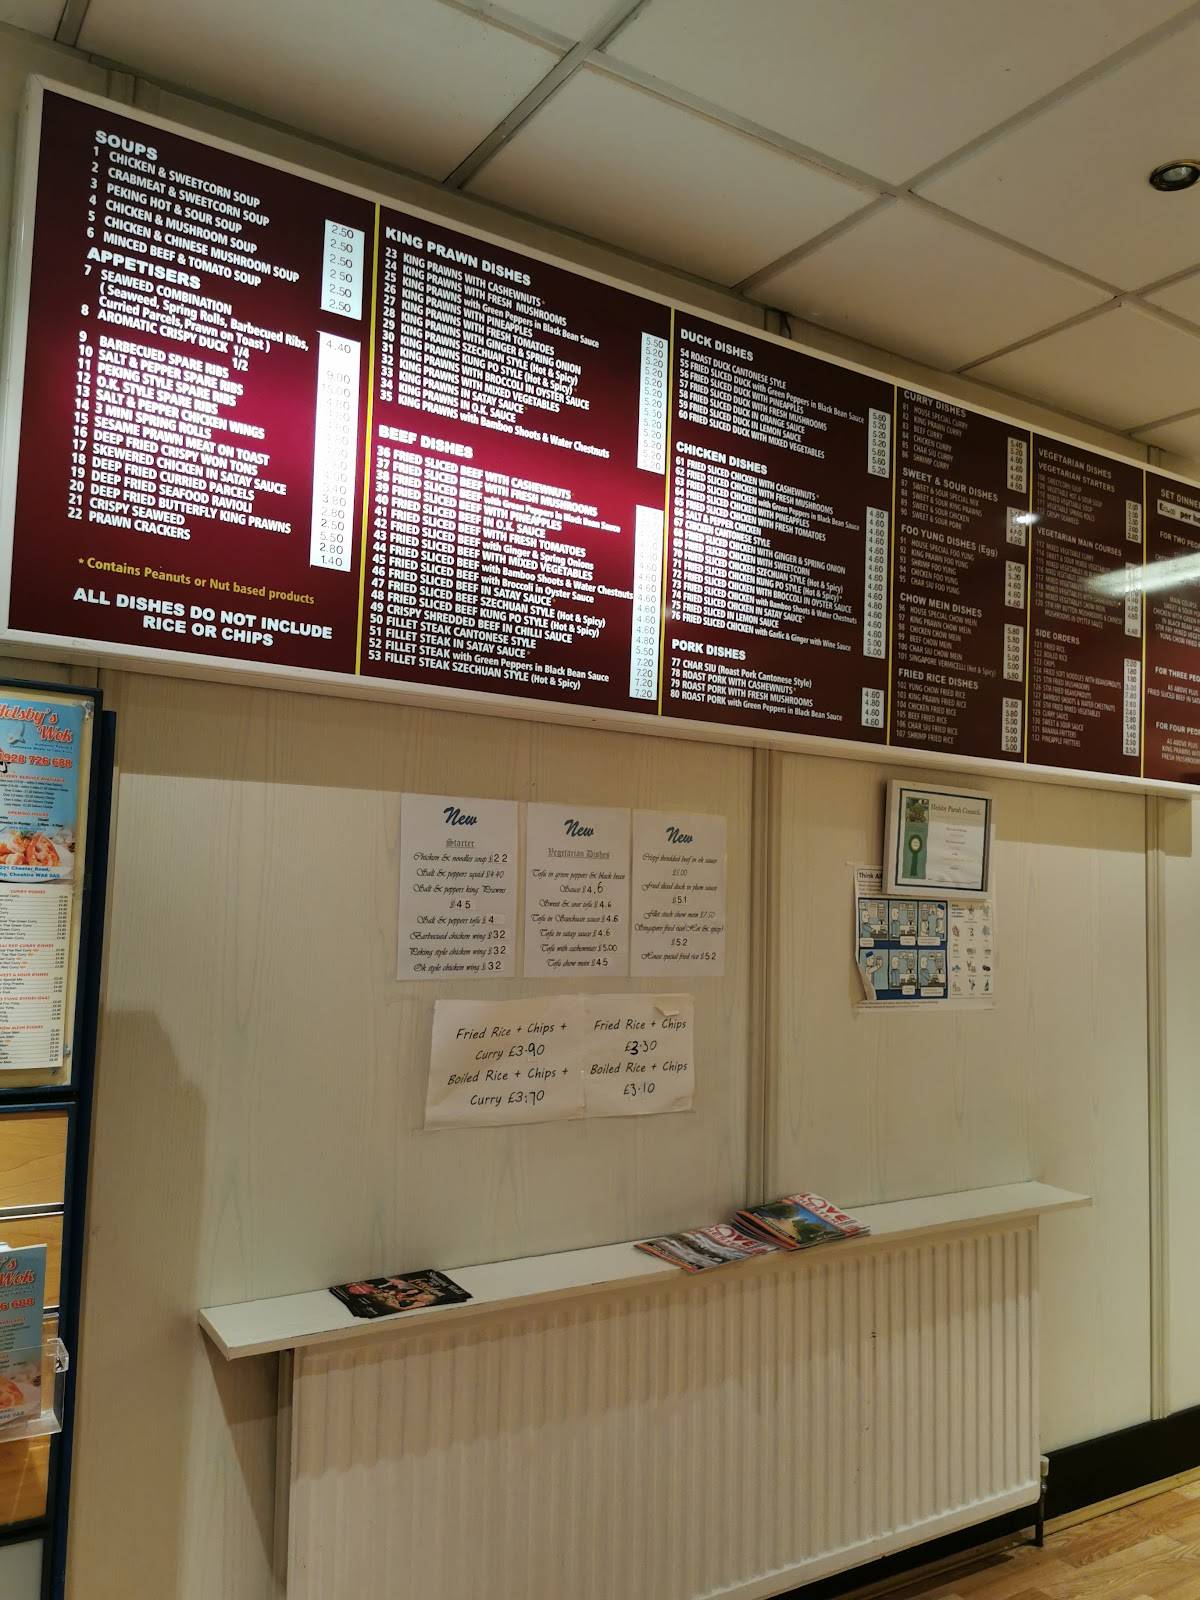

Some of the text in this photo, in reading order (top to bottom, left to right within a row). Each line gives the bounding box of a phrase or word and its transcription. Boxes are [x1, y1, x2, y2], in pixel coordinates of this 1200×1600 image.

[95, 129, 157, 161] SOUPS
[93, 145, 354, 241] 1 CHICKEN & SWEETCORN SOUP 2.50
[87, 246, 200, 289] APPETISERS
[385, 226, 530, 286] KING PRAWN DISHES
[84, 265, 232, 314] 7 SEAWEED COMBINATION
[385, 246, 540, 307] 23 KING PRAWNS WITH CASHEWNUTS
[680, 327, 753, 361] DUCK DISHES
[680, 347, 785, 389] 54 ROAST DUCK CANTONESE STYLE
[378, 425, 473, 459] BEEF DISHES
[676, 440, 767, 475] CHICKEN DISHES
[903, 467, 932, 483] SWEET
[944, 478, 966, 493] SOUR
[969, 486, 998, 502] DISHES
[1087, 463, 1112, 479] DISHES
[67, 508, 343, 567] 22 PRAWN CRACKERS 1.40
[901, 524, 998, 557] FOO YUNG DISHES (Egg)
[86, 557, 314, 604] Contains Peanuts or Nut based products
[73, 589, 332, 638] ALL DISHES DO NOT INCLUDE
[900, 592, 982, 618] CHOW MEIN DISHES
[142, 616, 273, 646] RICE OR CHIPS
[370, 613, 653, 668] 50 FILLET STEAK CANTONESE STYLE 7.20
[1035, 629, 1080, 645] SIDE ORDERS
[672, 638, 745, 660] PORK DISHES
[368, 649, 652, 699] 53 FILLET STEAK SZECHUAN STYLE (Hot & Spicy) 7.20
[671, 656, 811, 687] 77 CHAR SIU (Roast Pork Cantonese Style)
[899, 668, 978, 690] FRIED RICE DISHES
[671, 678, 812, 707] 79 ROAST PORK WITH FRESH MUSHROOMS
[443, 807, 477, 826] New
[564, 819, 594, 837] New
[665, 826, 694, 844] New
[456, 1025, 486, 1040] Fried
[491, 1026, 511, 1038] Rice
[527, 1022, 555, 1036] Chips
[594, 1019, 621, 1032] Fried
[625, 1018, 645, 1030] Rice
[661, 1018, 686, 1031] Chips
[475, 1049, 504, 1061] Curry
[590, 1062, 622, 1075] Boiled
[626, 1063, 647, 1073] Rice
[662, 1061, 688, 1073] Chips
[447, 1071, 479, 1086] Boiled
[485, 1070, 509, 1082] Rice
[527, 1067, 556, 1080] Chips
[470, 1094, 502, 1107] Curry
